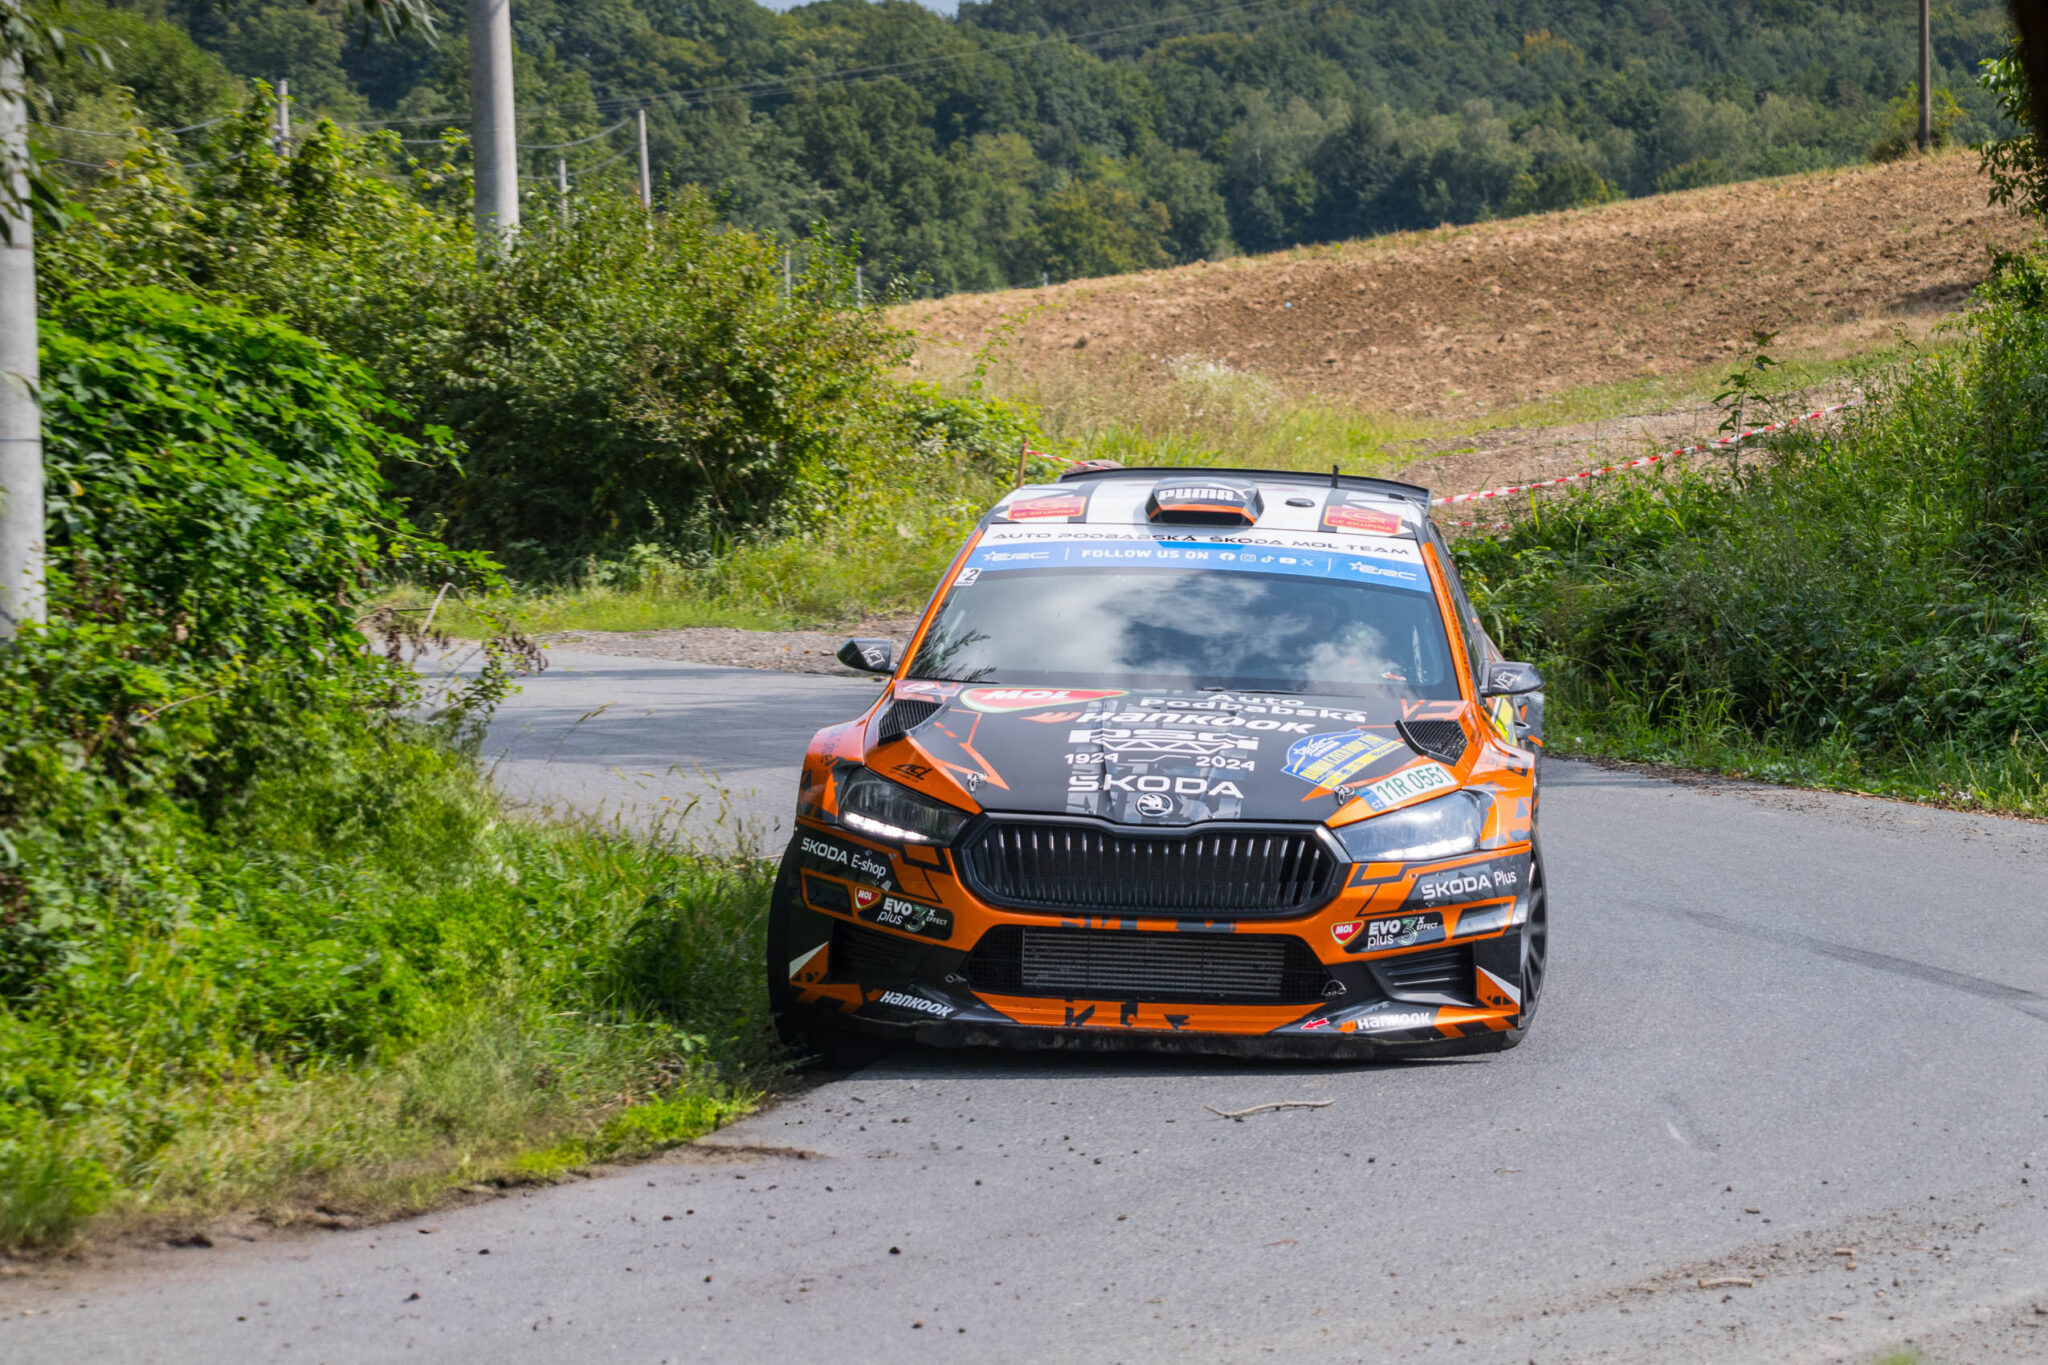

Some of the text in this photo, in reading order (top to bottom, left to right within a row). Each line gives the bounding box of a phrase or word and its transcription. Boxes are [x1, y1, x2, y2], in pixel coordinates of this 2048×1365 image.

[1158, 487, 1234, 501] PUMA
[1082, 549, 1151, 558] FOLLOW
[1157, 549, 1180, 559] US
[1185, 551, 1209, 560] ON
[1292, 541, 1338, 549] MOL
[1346, 544, 1409, 555] TEAM
[981, 690, 1071, 700] MOL
[1206, 694, 1305, 706] Auto
[1064, 753, 1255, 771] 1924 2024
[1376, 765, 1452, 800] 11R 0551
[1371, 800, 1384, 809] CZ
[851, 854, 886, 879] E-shop
[1493, 869, 1517, 886] Plus
[858, 889, 873, 900] MOL
[883, 897, 913, 916] EVO
[877, 911, 903, 925] plus
[926, 915, 948, 925] EFFECT
[1335, 924, 1353, 934] MOL
[1368, 919, 1401, 936] EVO
[1416, 922, 1438, 931] EFFECT
[1367, 933, 1394, 949] plus
